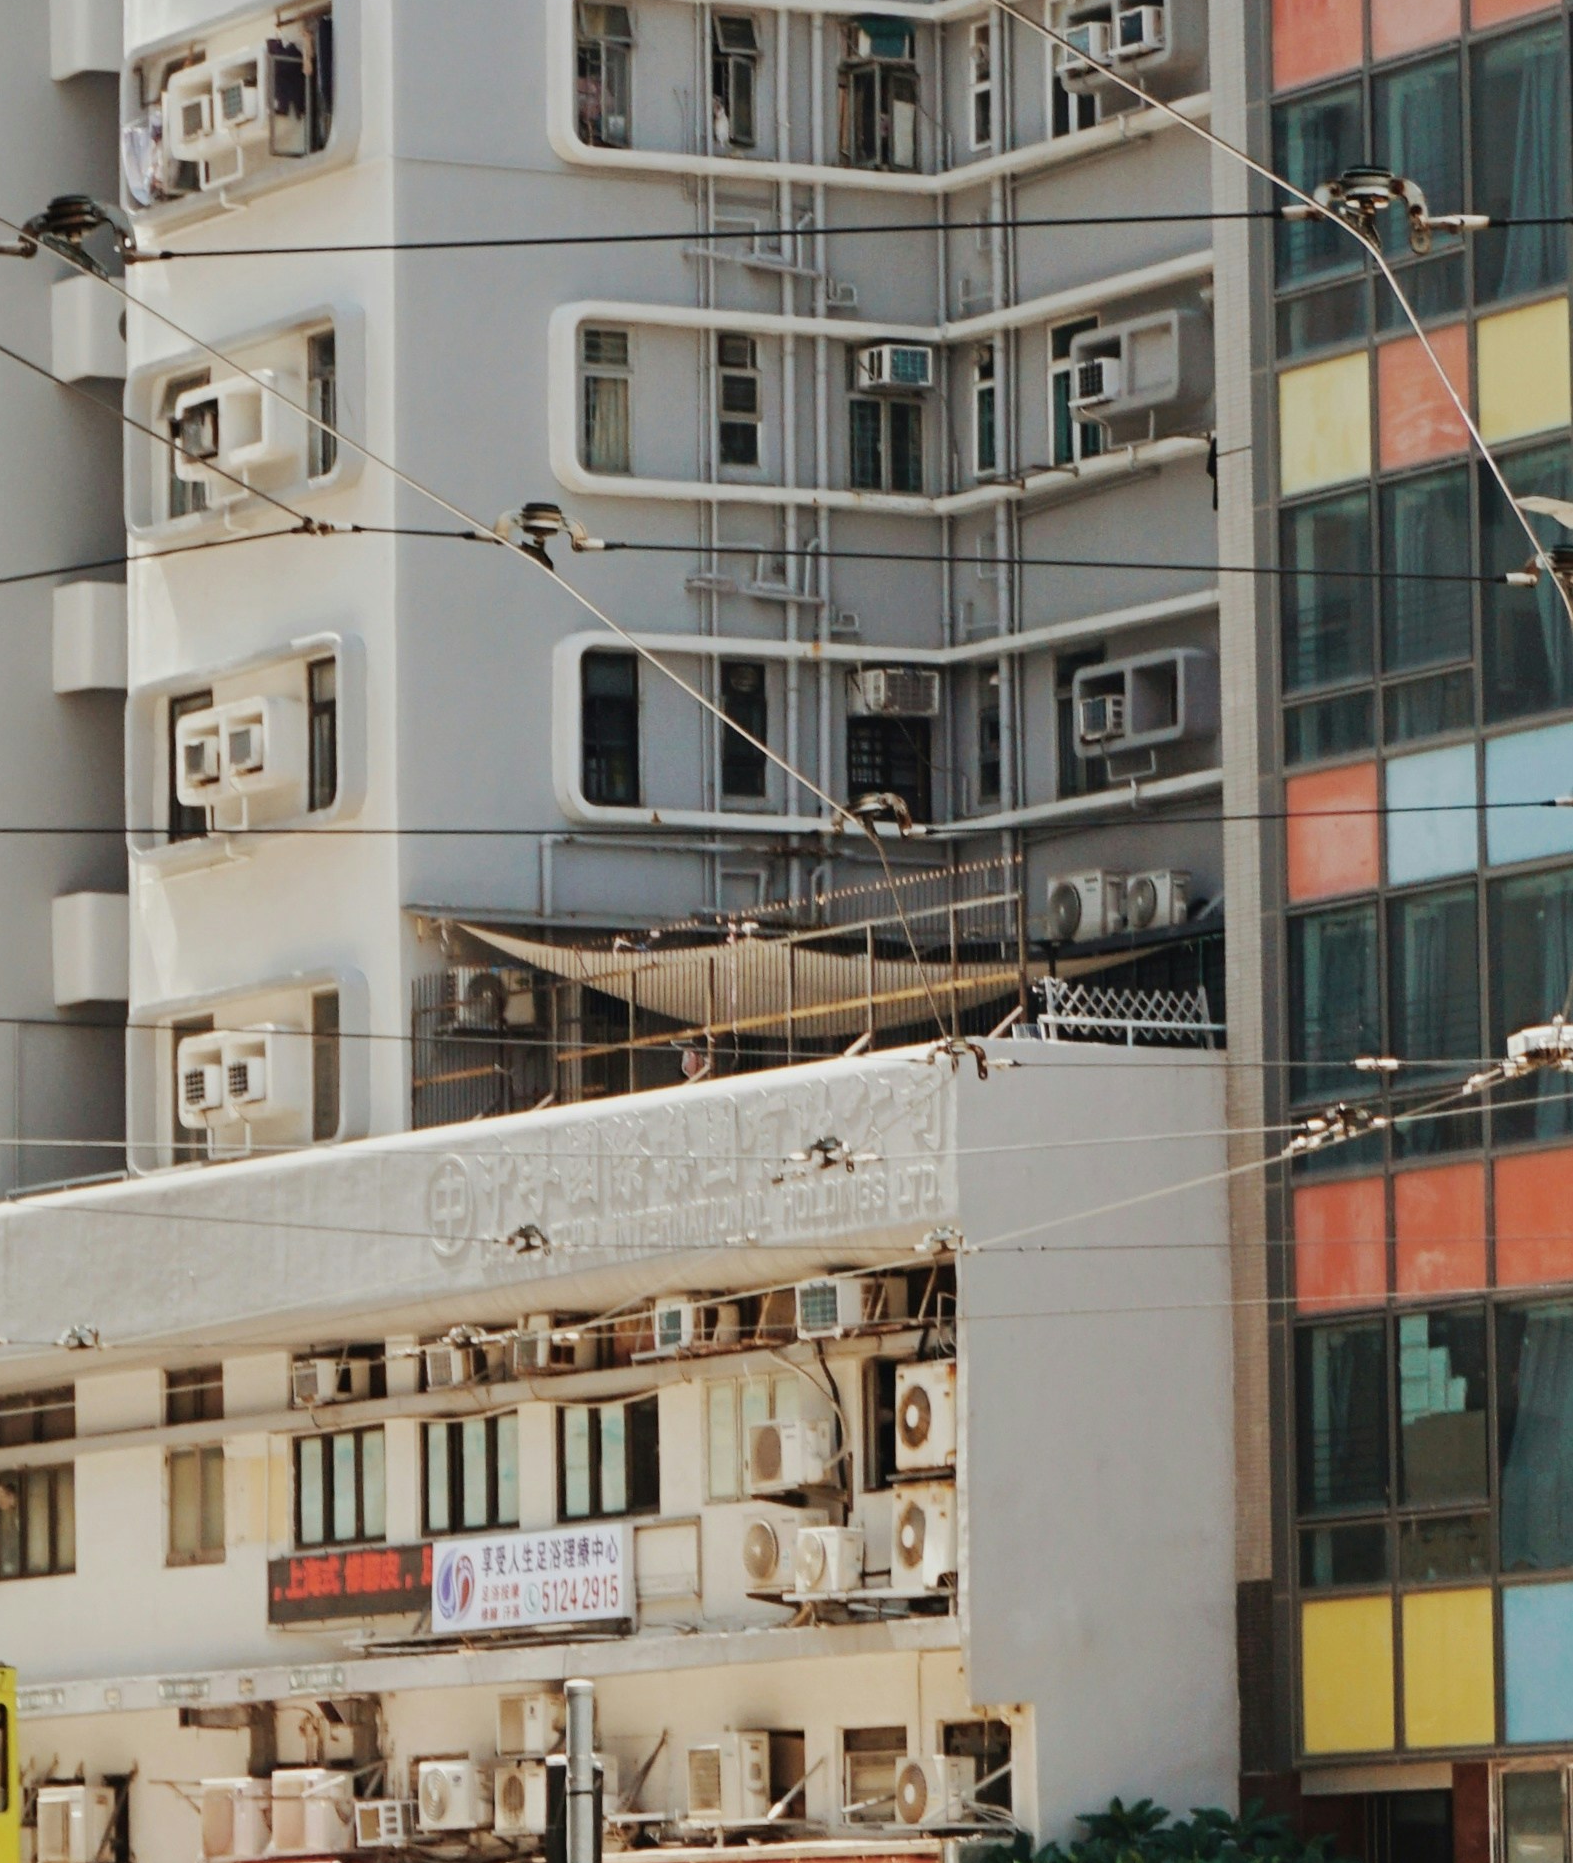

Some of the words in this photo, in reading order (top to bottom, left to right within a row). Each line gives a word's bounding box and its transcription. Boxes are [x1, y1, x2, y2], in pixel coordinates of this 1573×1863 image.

[782, 1173, 885, 1232] HOLDINGS
[481, 1535, 618, 1577] 享受人生足浴理療中心
[542, 1577, 577, 1614] 5124
[583, 1574, 619, 1609] 2915
